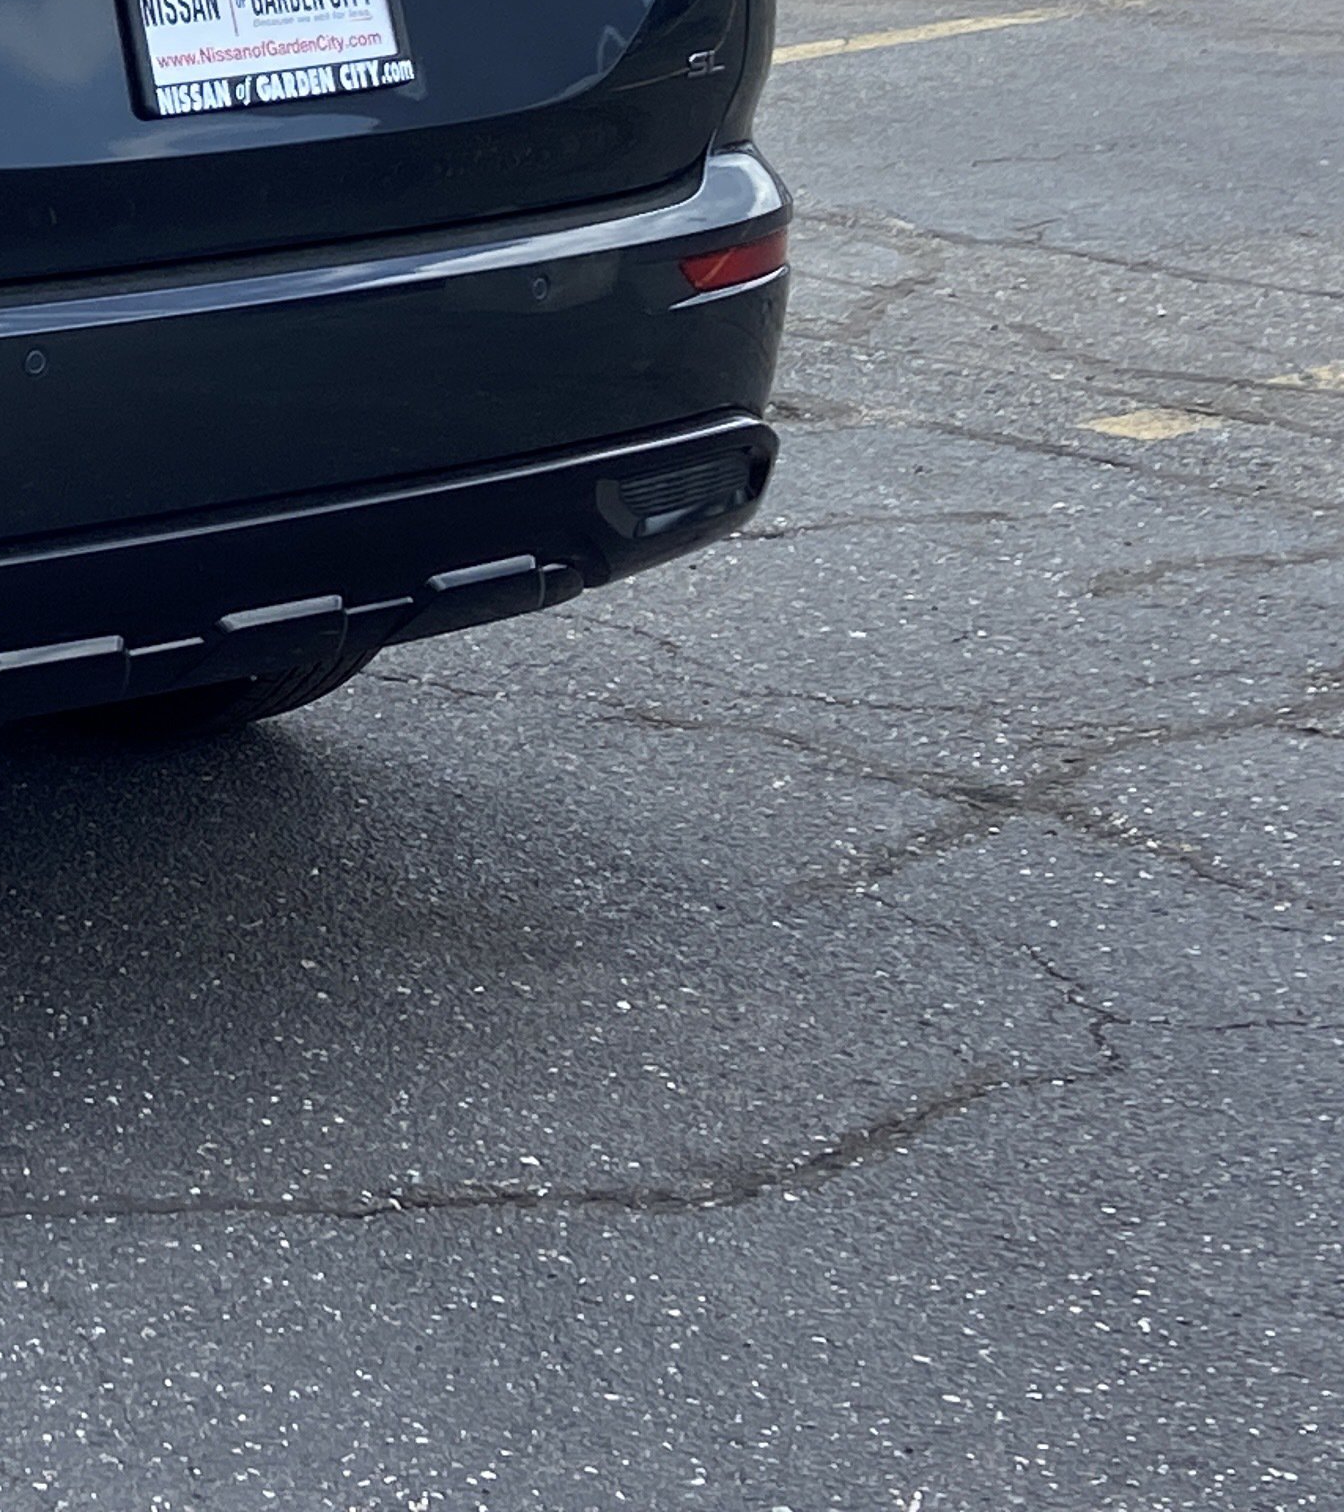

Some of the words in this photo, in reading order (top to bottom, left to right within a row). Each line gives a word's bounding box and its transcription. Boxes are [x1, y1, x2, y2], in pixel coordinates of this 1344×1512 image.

[156, 30, 383, 69] www.NissanofGardenCity.com
[156, 80, 232, 115] NISSAN
[236, 75, 252, 106] of
[256, 67, 336, 102] GARDEN
[339, 58, 415, 90] CITY.com
